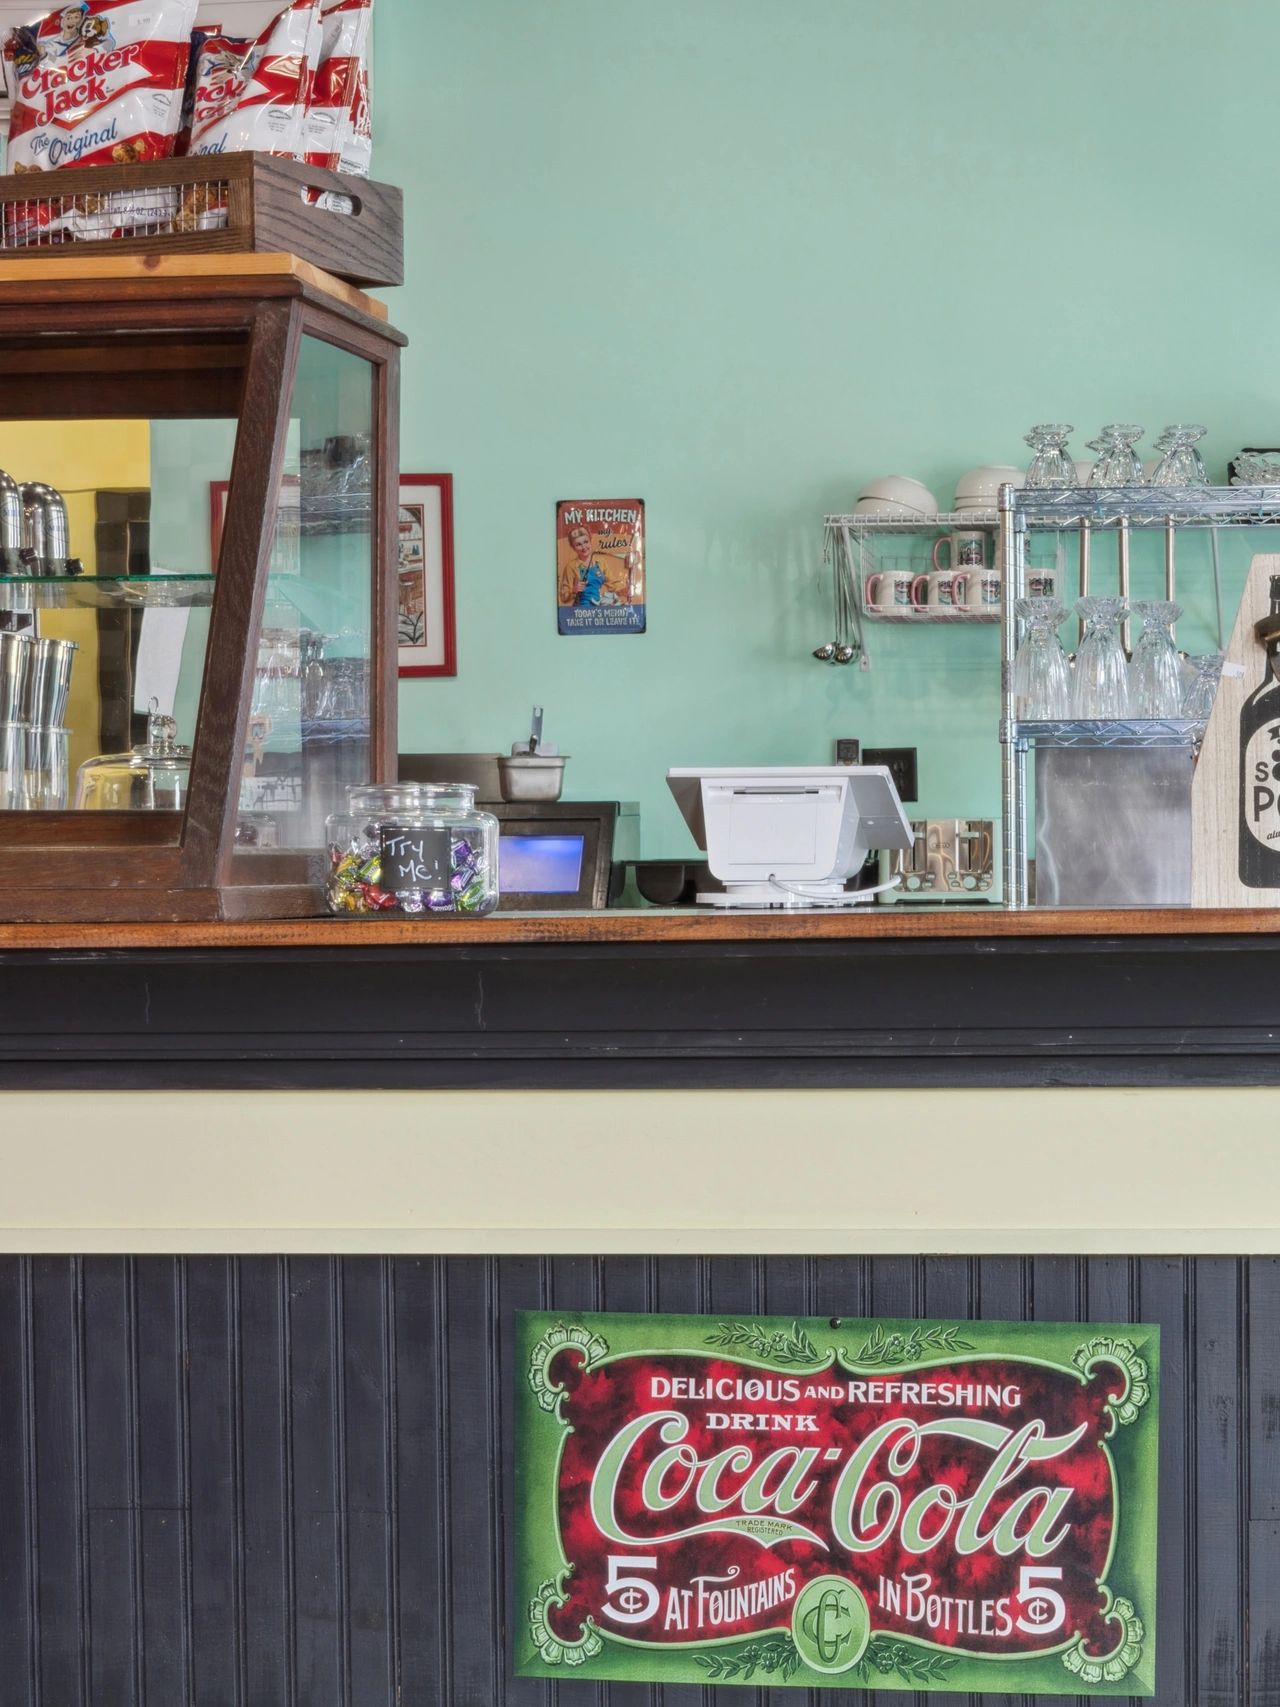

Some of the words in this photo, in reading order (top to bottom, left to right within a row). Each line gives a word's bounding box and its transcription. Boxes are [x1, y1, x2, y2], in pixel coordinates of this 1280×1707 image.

[20, 45, 140, 100] Cracker
[36, 76, 109, 127] Jack
[30, 132, 51, 156] The
[49, 118, 118, 165] Original
[564, 510, 582, 525] MY
[586, 508, 636, 523] KITCHEN
[567, 618, 583, 627] TAKE
[606, 617, 627, 626] LEAVE
[574, 608, 602, 618] TODAY'S
[385, 835, 424, 862] Try
[651, 1376, 801, 1402] DELICIOUS
[804, 1385, 845, 1400] AND
[848, 1381, 1022, 1408] REFRESHING
[705, 1412, 820, 1432] DRINK
[735, 1519, 766, 1528] TRADE
[767, 1521, 793, 1532] MARK
[746, 1526, 784, 1536] REGISTERED
[664, 1586, 693, 1631] AT
[878, 1575, 902, 1617] IN
